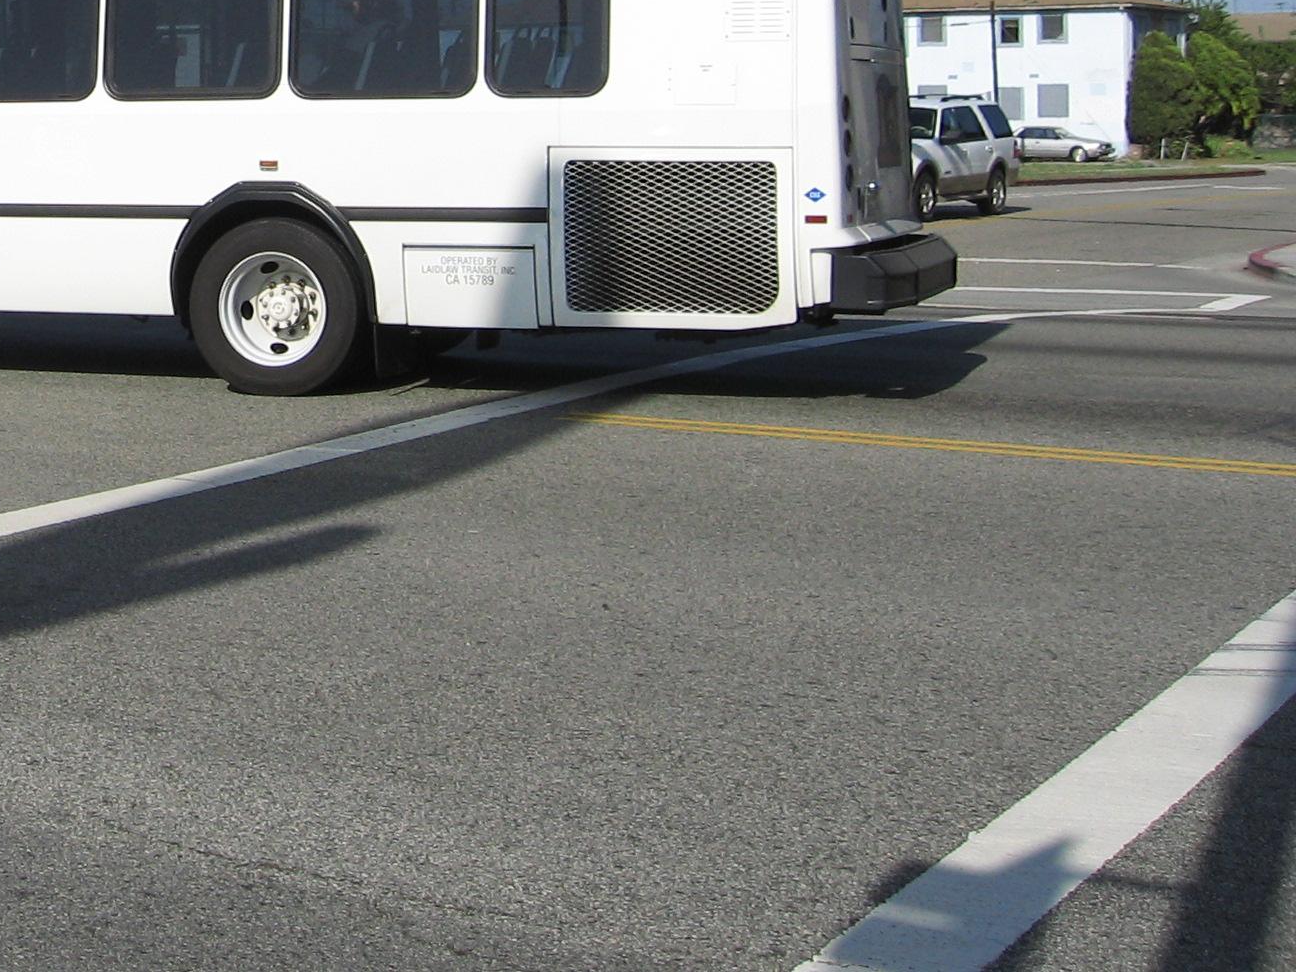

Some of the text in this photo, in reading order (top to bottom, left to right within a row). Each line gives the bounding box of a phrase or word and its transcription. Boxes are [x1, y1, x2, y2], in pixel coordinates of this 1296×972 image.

[440, 256, 498, 266] OPERATED BY
[421, 265, 459, 274] LAIDLAW
[445, 274, 495, 286] CA 15789
